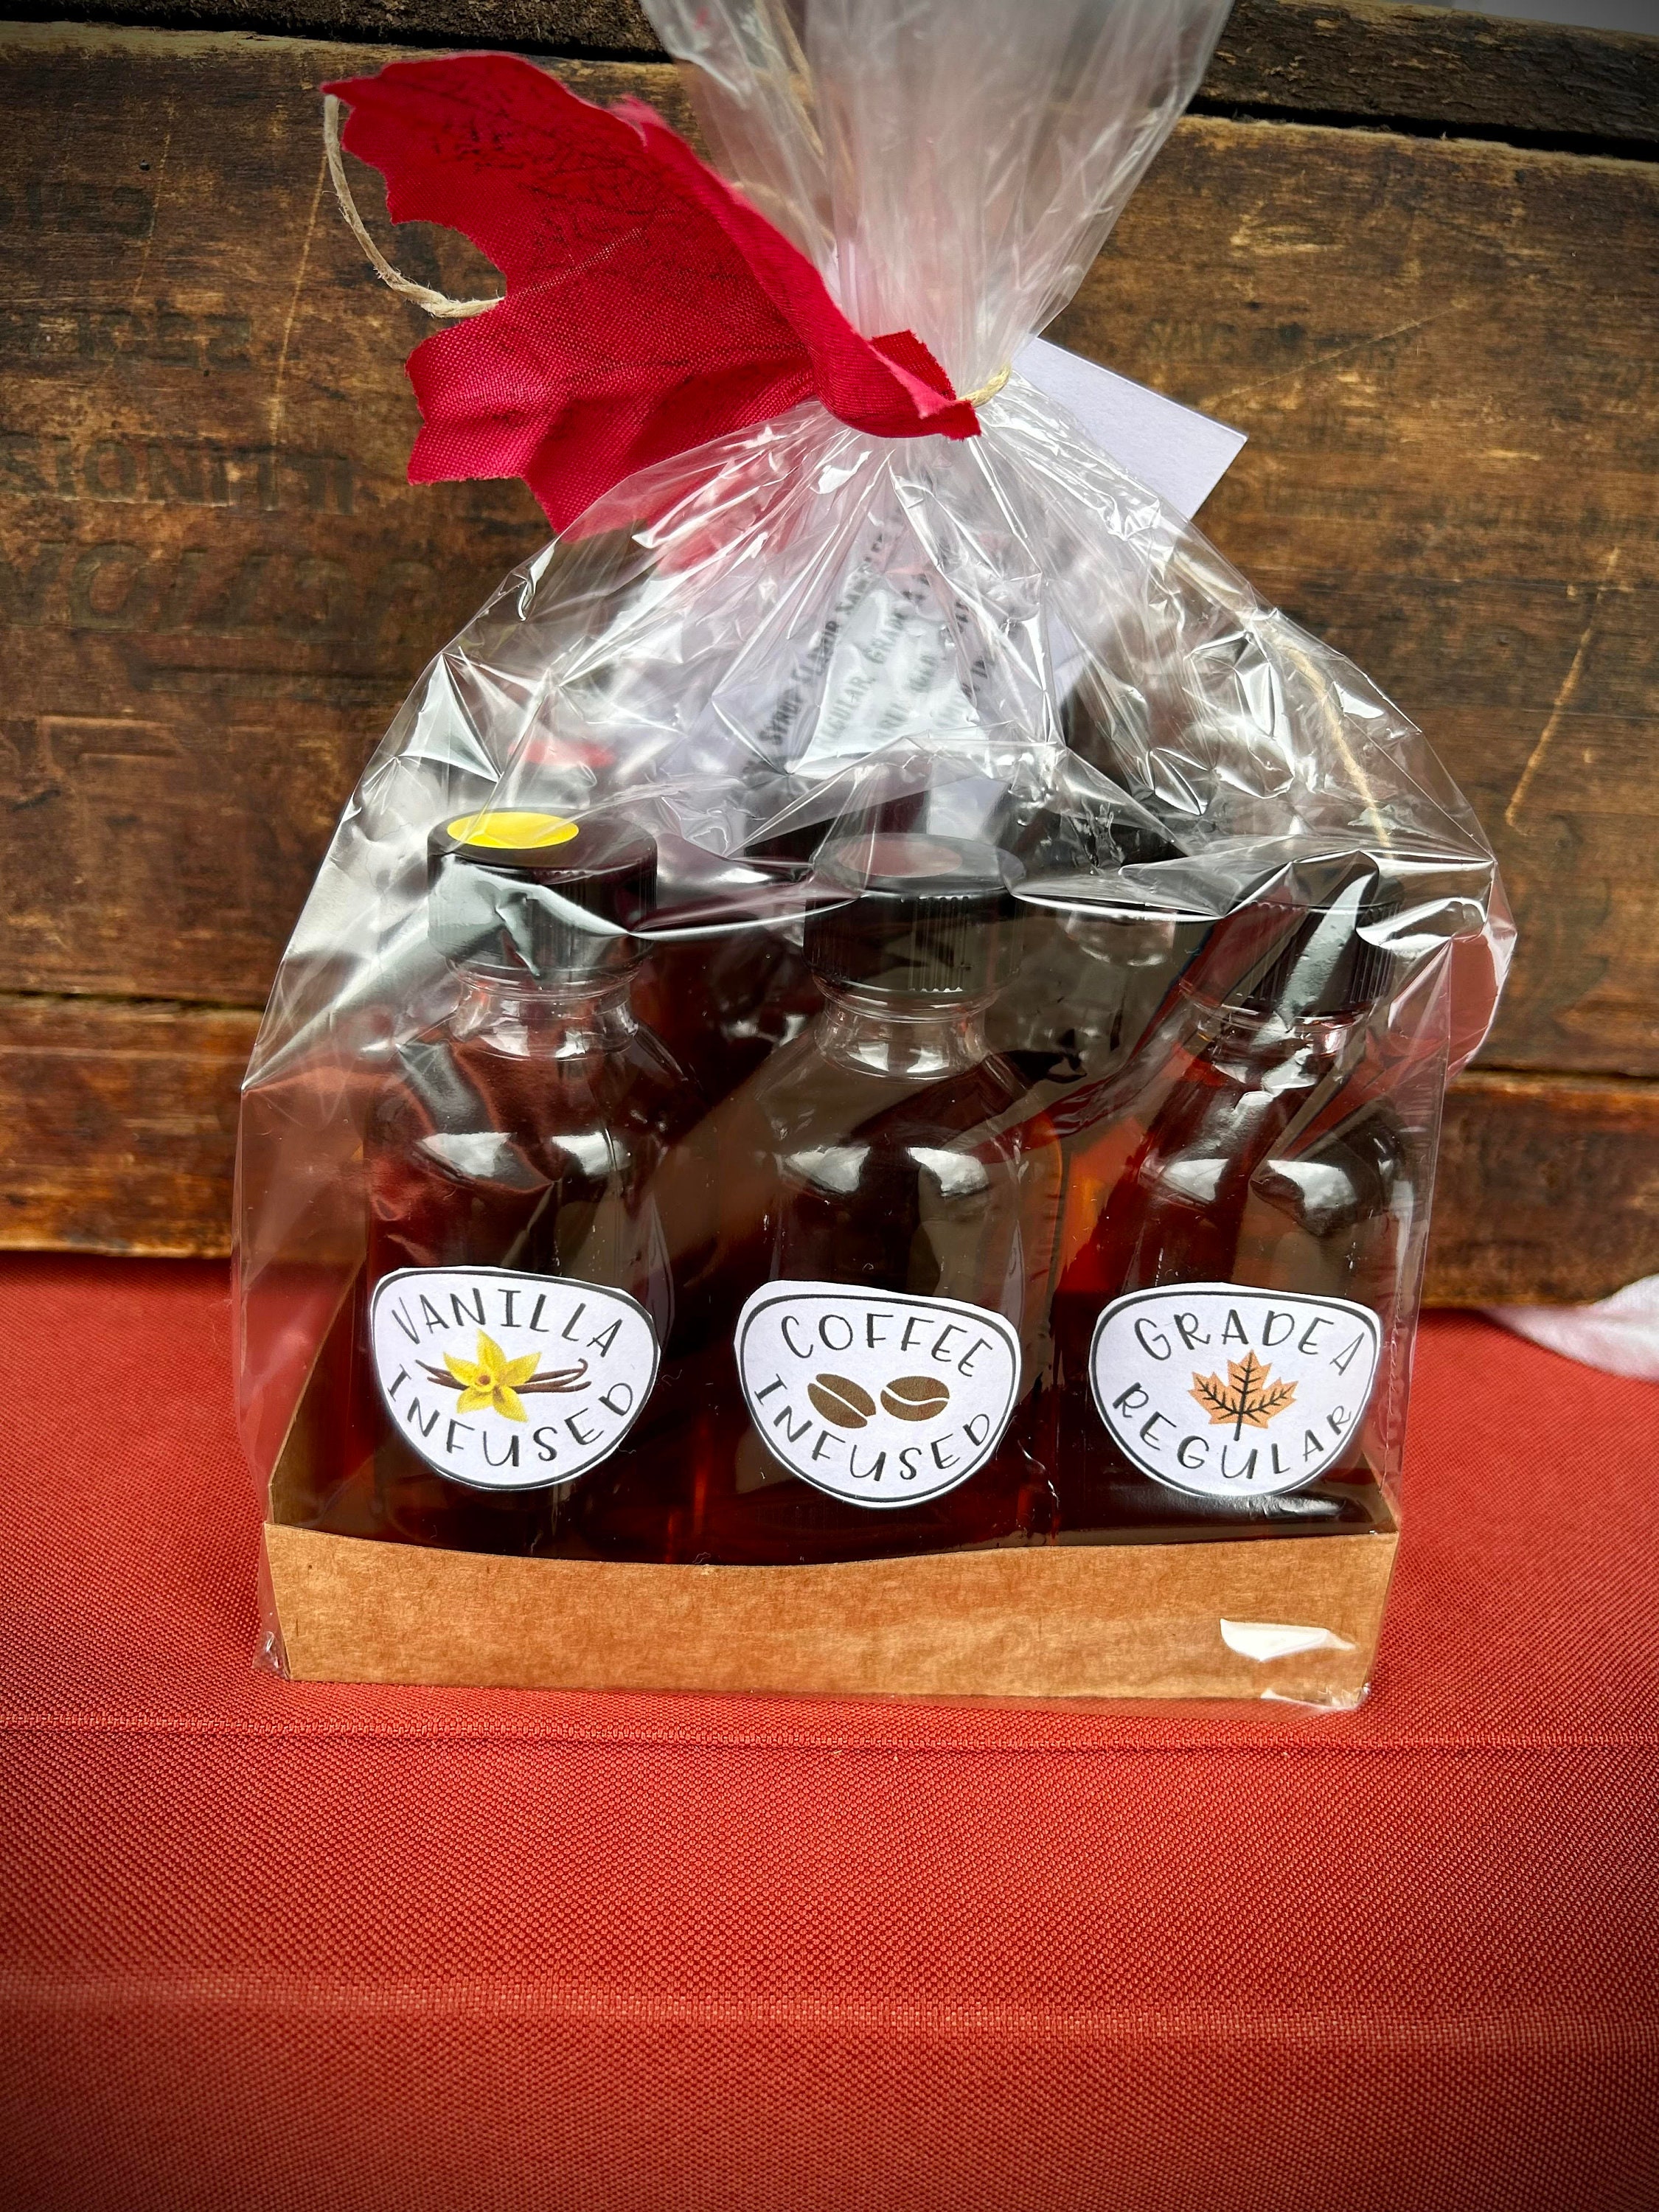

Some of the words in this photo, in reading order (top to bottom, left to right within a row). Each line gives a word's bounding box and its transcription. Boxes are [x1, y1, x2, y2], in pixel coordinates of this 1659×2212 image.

[392, 1287, 623, 1357] VANILLA
[781, 1313, 993, 1377] COFFEE
[1134, 1309, 1335, 1360] GRADE
[1329, 1332, 1365, 1376] A
[388, 1363, 633, 1467] INFUSED
[754, 1374, 990, 1481] INFUSED
[1112, 1382, 1352, 1479] REGULAR
